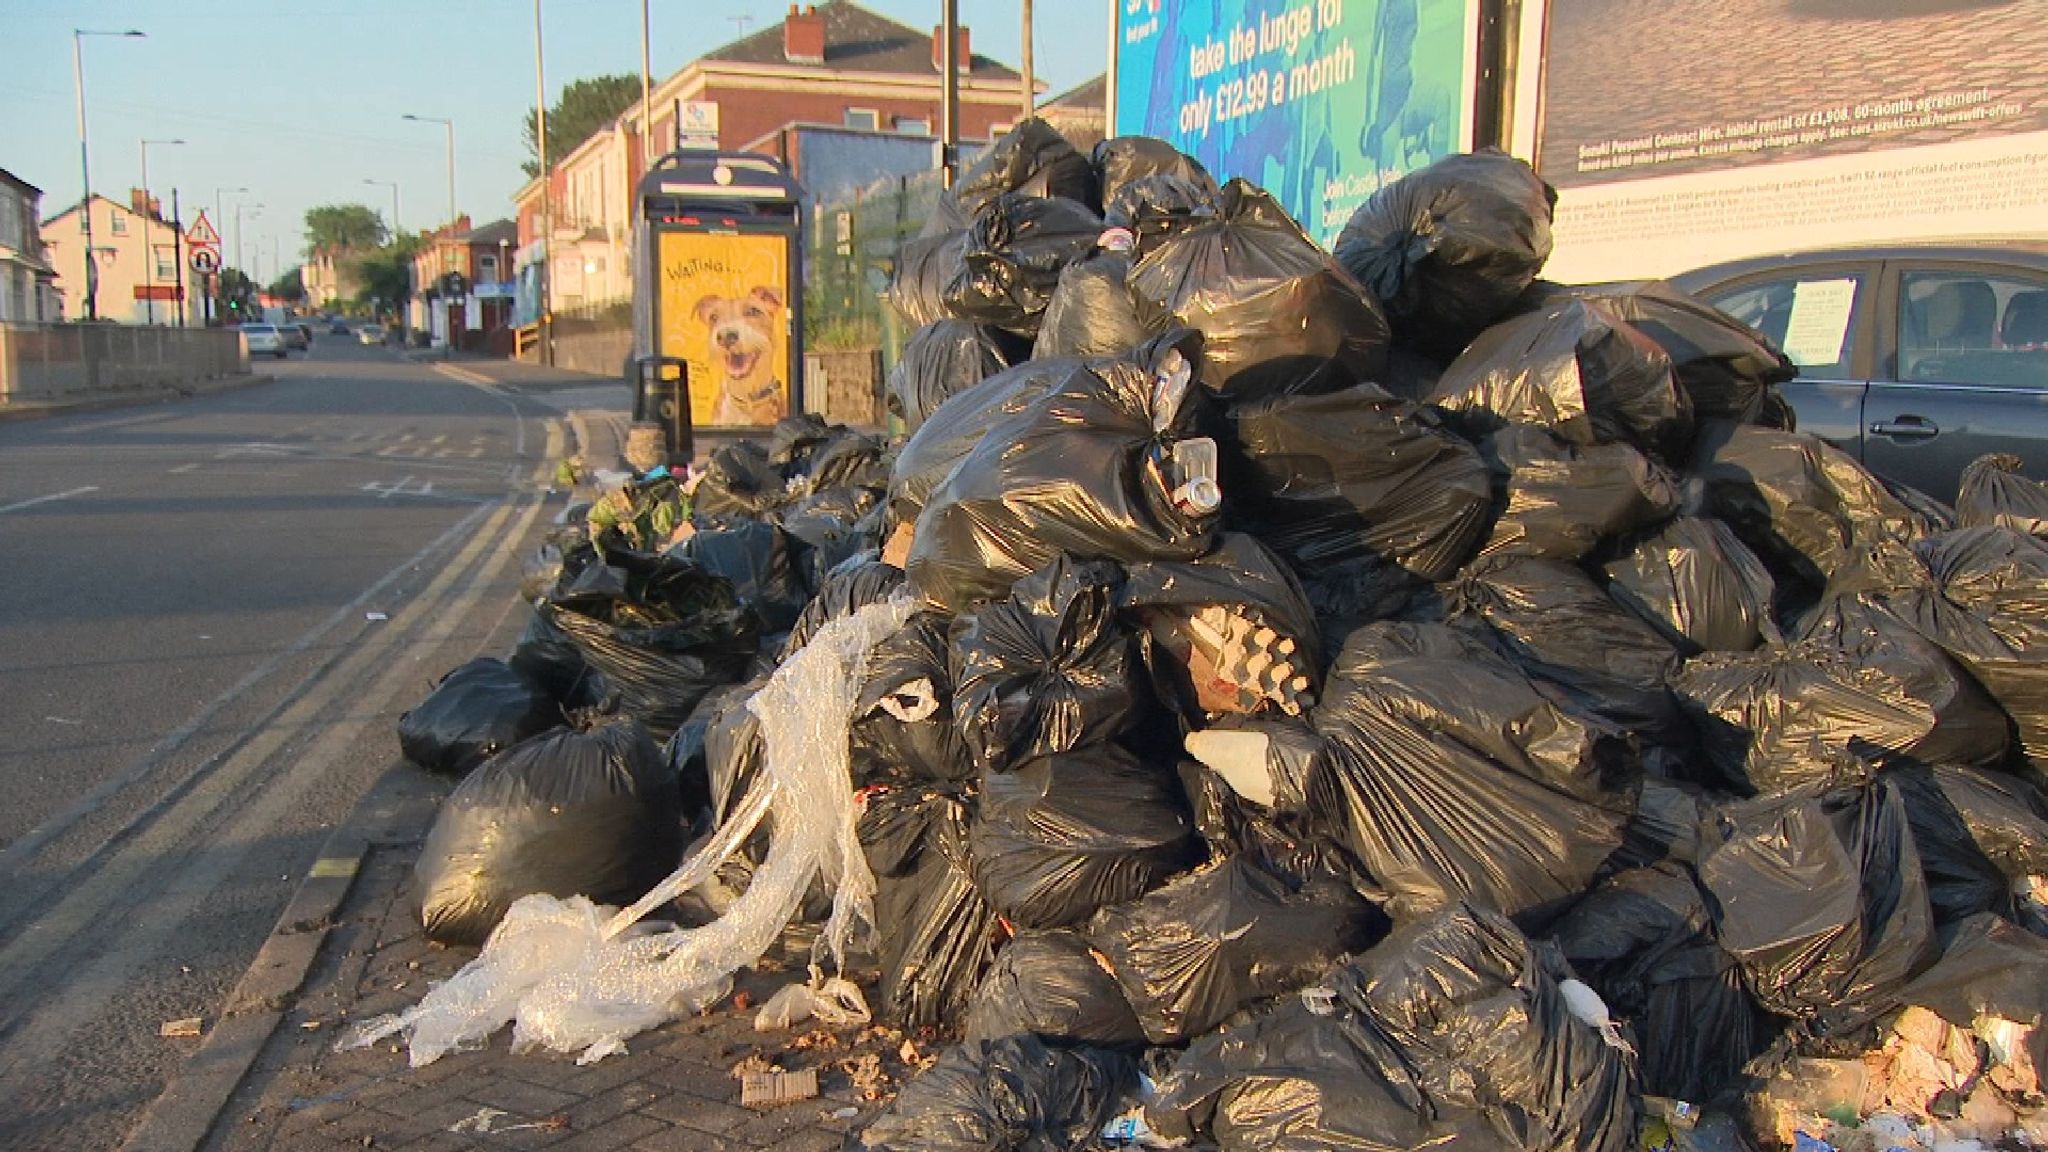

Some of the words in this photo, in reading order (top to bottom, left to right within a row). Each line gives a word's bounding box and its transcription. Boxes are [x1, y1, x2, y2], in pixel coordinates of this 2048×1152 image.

[1190, 33, 1225, 79] take
[1229, 21, 1256, 65] the
[1259, 9, 1312, 56] lunge
[1180, 88, 1212, 139] only
[1215, 69, 1268, 122] £12.99
[1272, 71, 1285, 105] a
[1289, 37, 1355, 100] month
[1759, 114, 1793, 134] rental
[1795, 111, 1807, 128] of
[1854, 97, 1913, 119] 60-month
